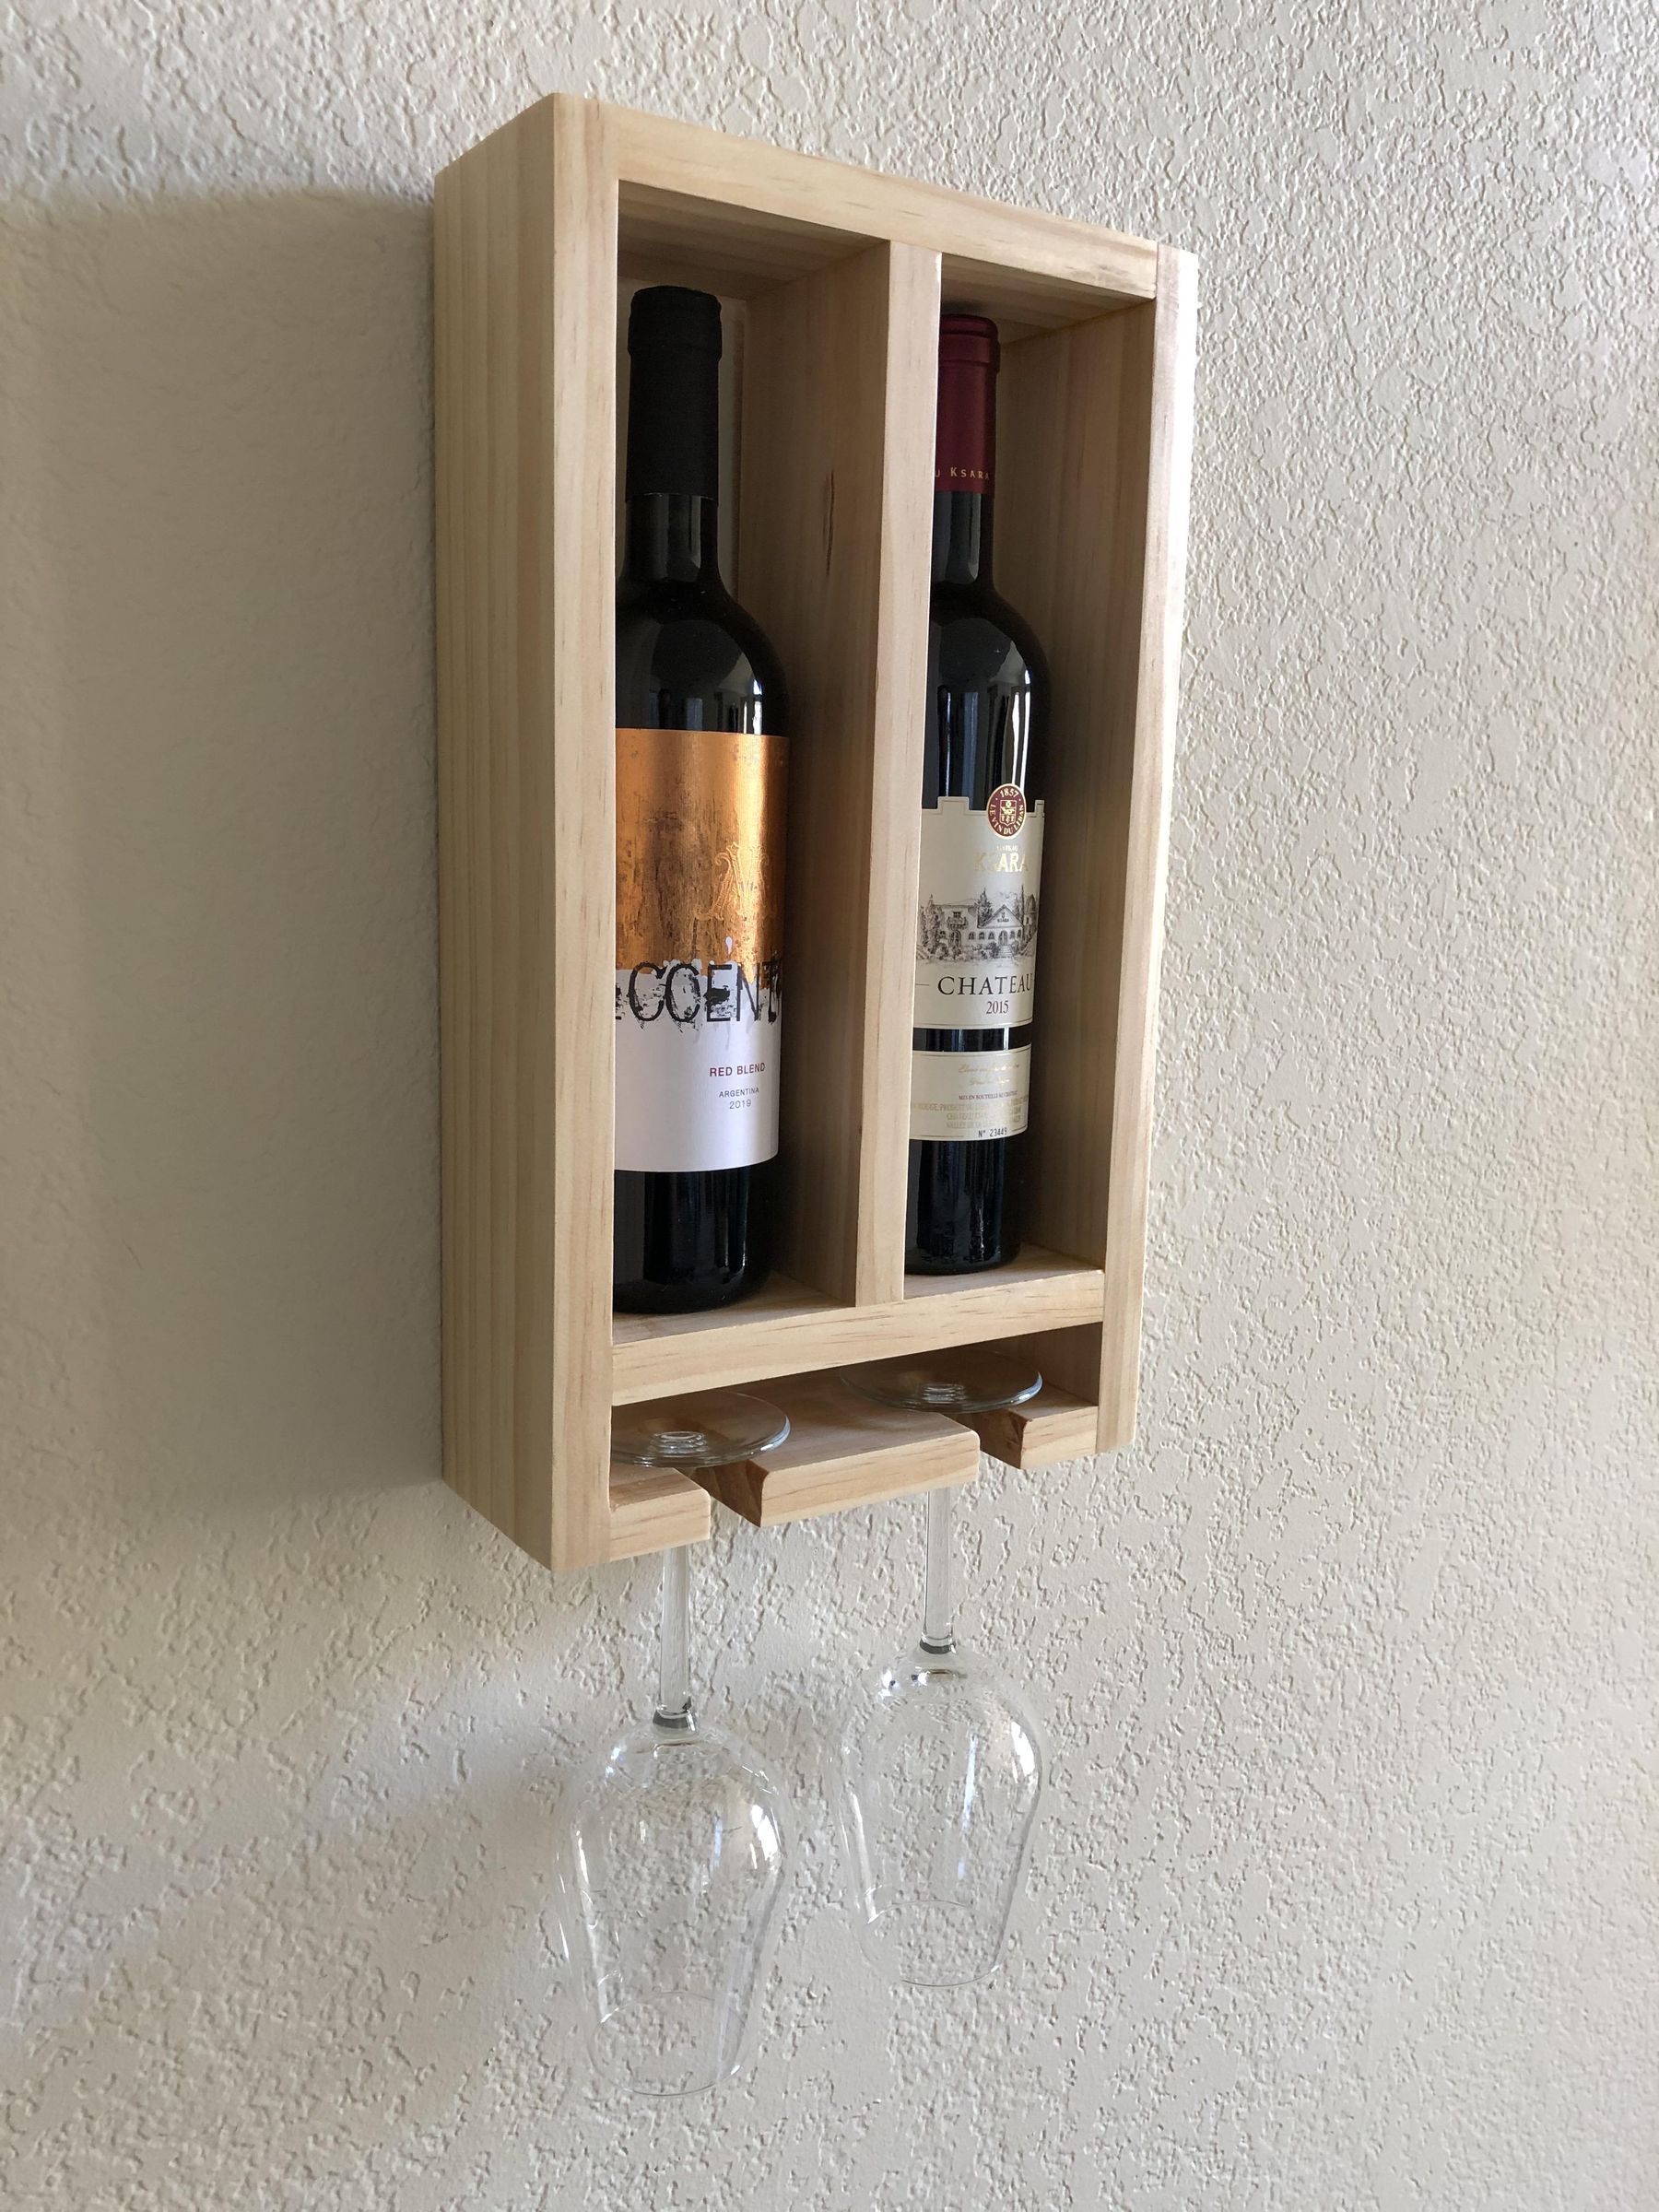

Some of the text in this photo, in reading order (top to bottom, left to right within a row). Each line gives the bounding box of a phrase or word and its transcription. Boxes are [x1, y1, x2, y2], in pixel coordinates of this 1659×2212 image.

[950, 466, 990, 479] KSARA
[999, 787, 1019, 798] 1857
[989, 804, 996, 817] LE
[992, 817, 1003, 832] VIN
[1004, 827, 1014, 835] DU
[937, 972, 1033, 995] CHATEAU
[985, 999, 1009, 1015] 2015
[709, 1062, 766, 1077] RED BLEND
[718, 1087, 759, 1099] ARGENTINA
[729, 1099, 752, 1110] 2019
[989, 1126, 1007, 1137] 23449
